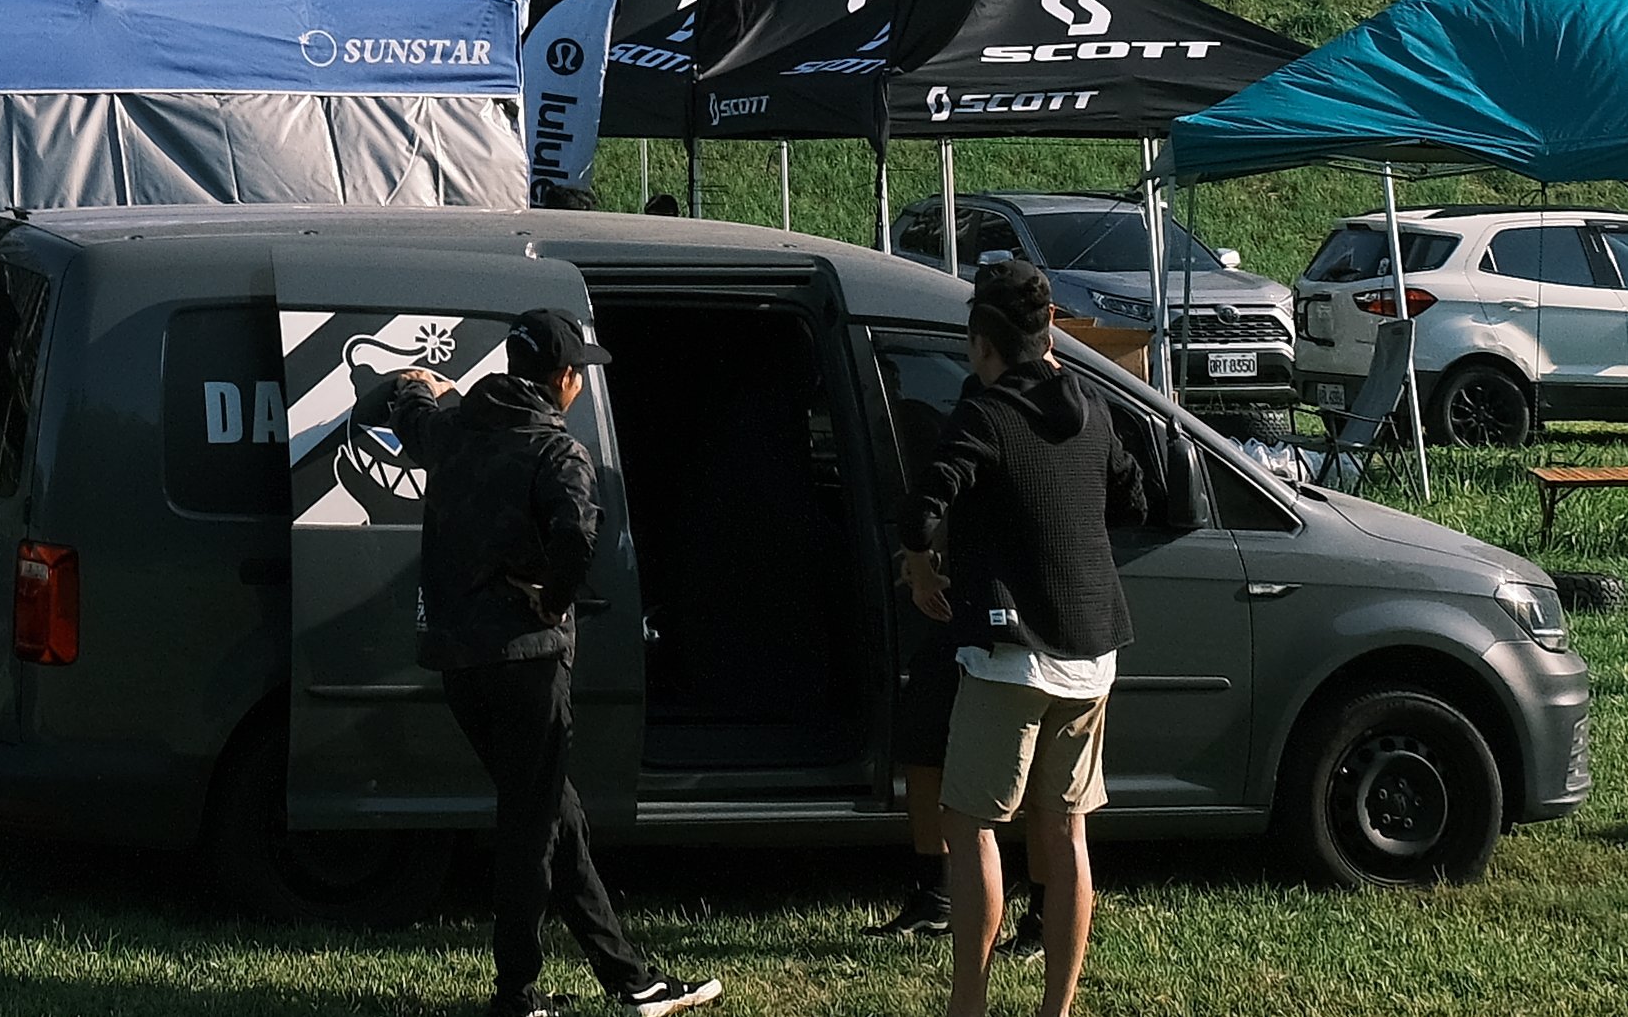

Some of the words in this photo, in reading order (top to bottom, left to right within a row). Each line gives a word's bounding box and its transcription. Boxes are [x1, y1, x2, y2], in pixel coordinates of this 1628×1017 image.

[344, 38, 491, 66] SUNSTAR
[979, 40, 1222, 63] SCOTT
[719, 95, 769, 117] SCOTT
[953, 90, 1100, 114] SCOTT
[204, 381, 288, 443] DA
